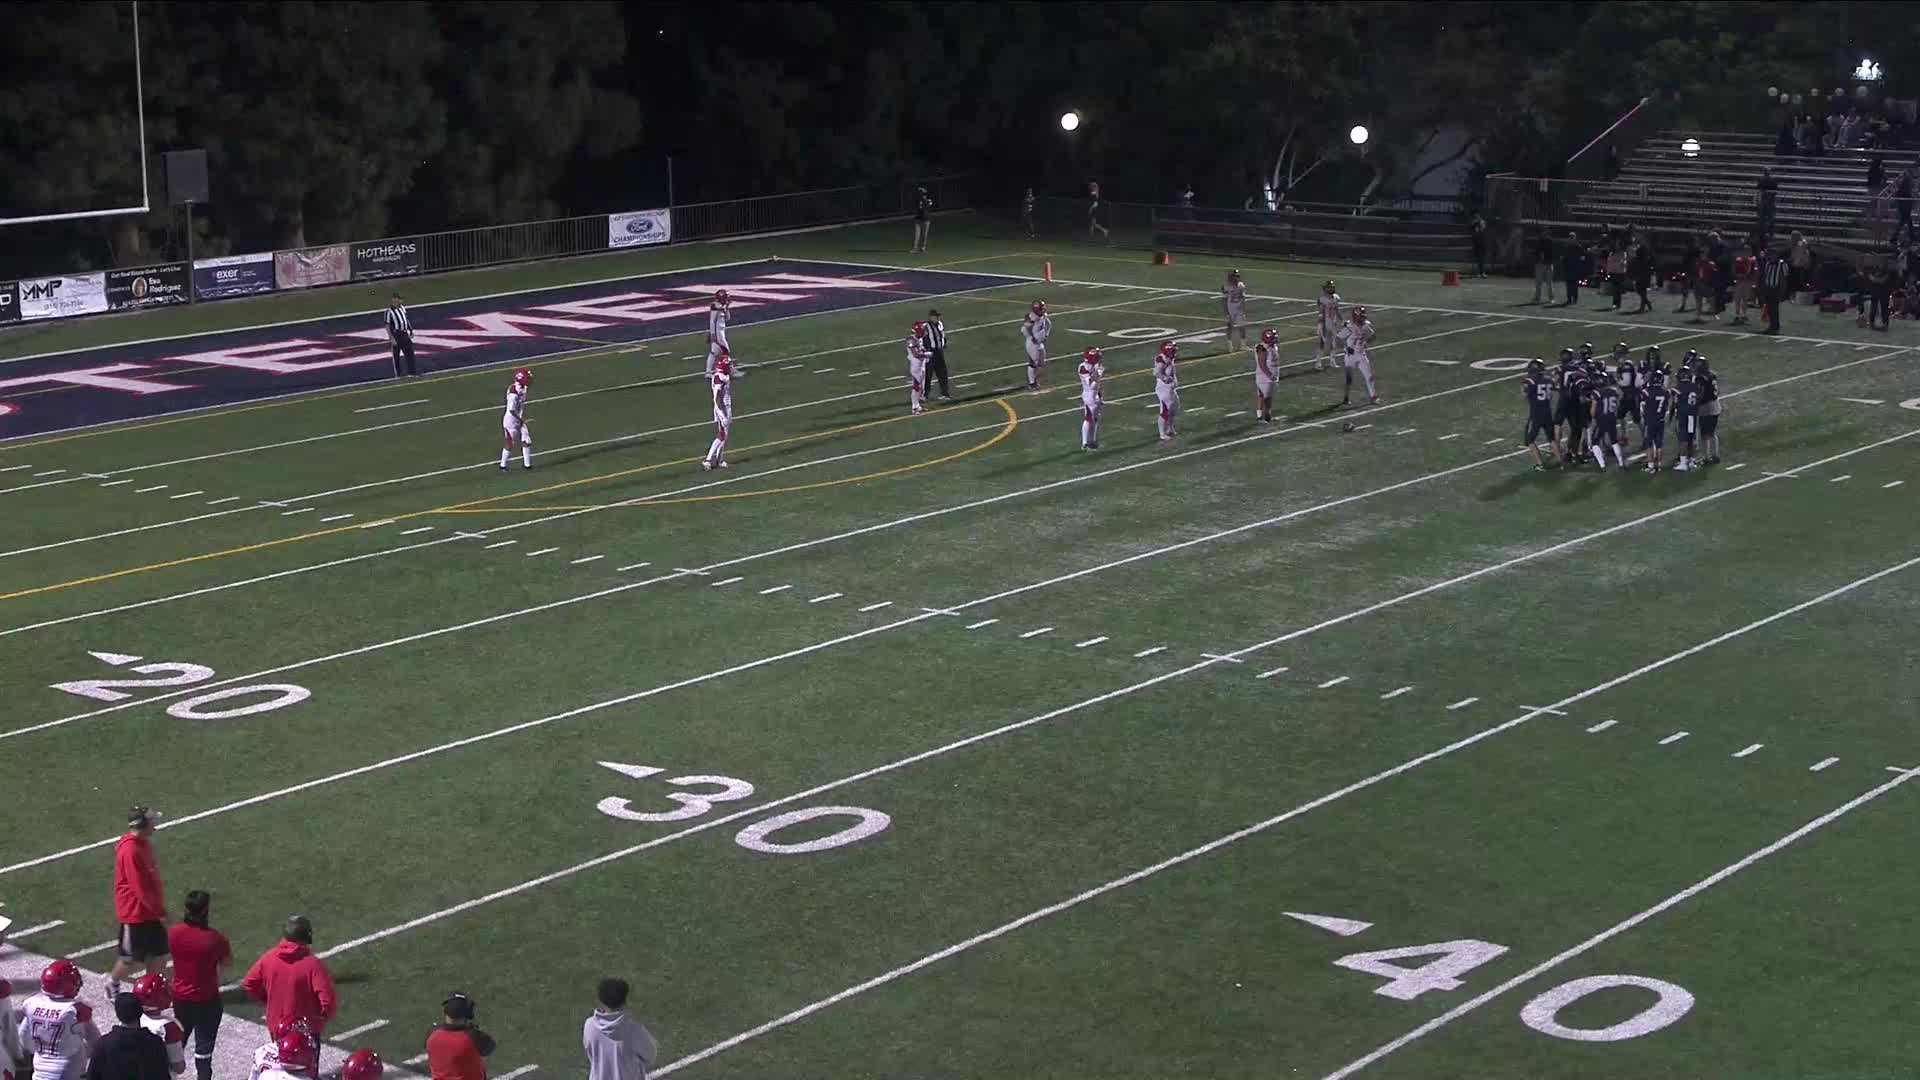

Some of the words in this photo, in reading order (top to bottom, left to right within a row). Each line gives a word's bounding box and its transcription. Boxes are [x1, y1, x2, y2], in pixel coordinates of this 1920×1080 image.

[357, 243, 417, 260] HOTHEADS
[149, 277, 161, 285] Eva
[216, 268, 239, 279] exer
[22, 280, 62, 300] MMP
[150, 284, 181, 294] Rodriguez
[0, 266, 908, 417] TEMEN
[1655, 396, 1665, 413] 7
[48, 662, 312, 719] 20
[596, 775, 891, 854] 30
[1333, 939, 1695, 1042] 40
[33, 1007, 61, 1019] BEARS
[32, 1021, 65, 1057] 57
